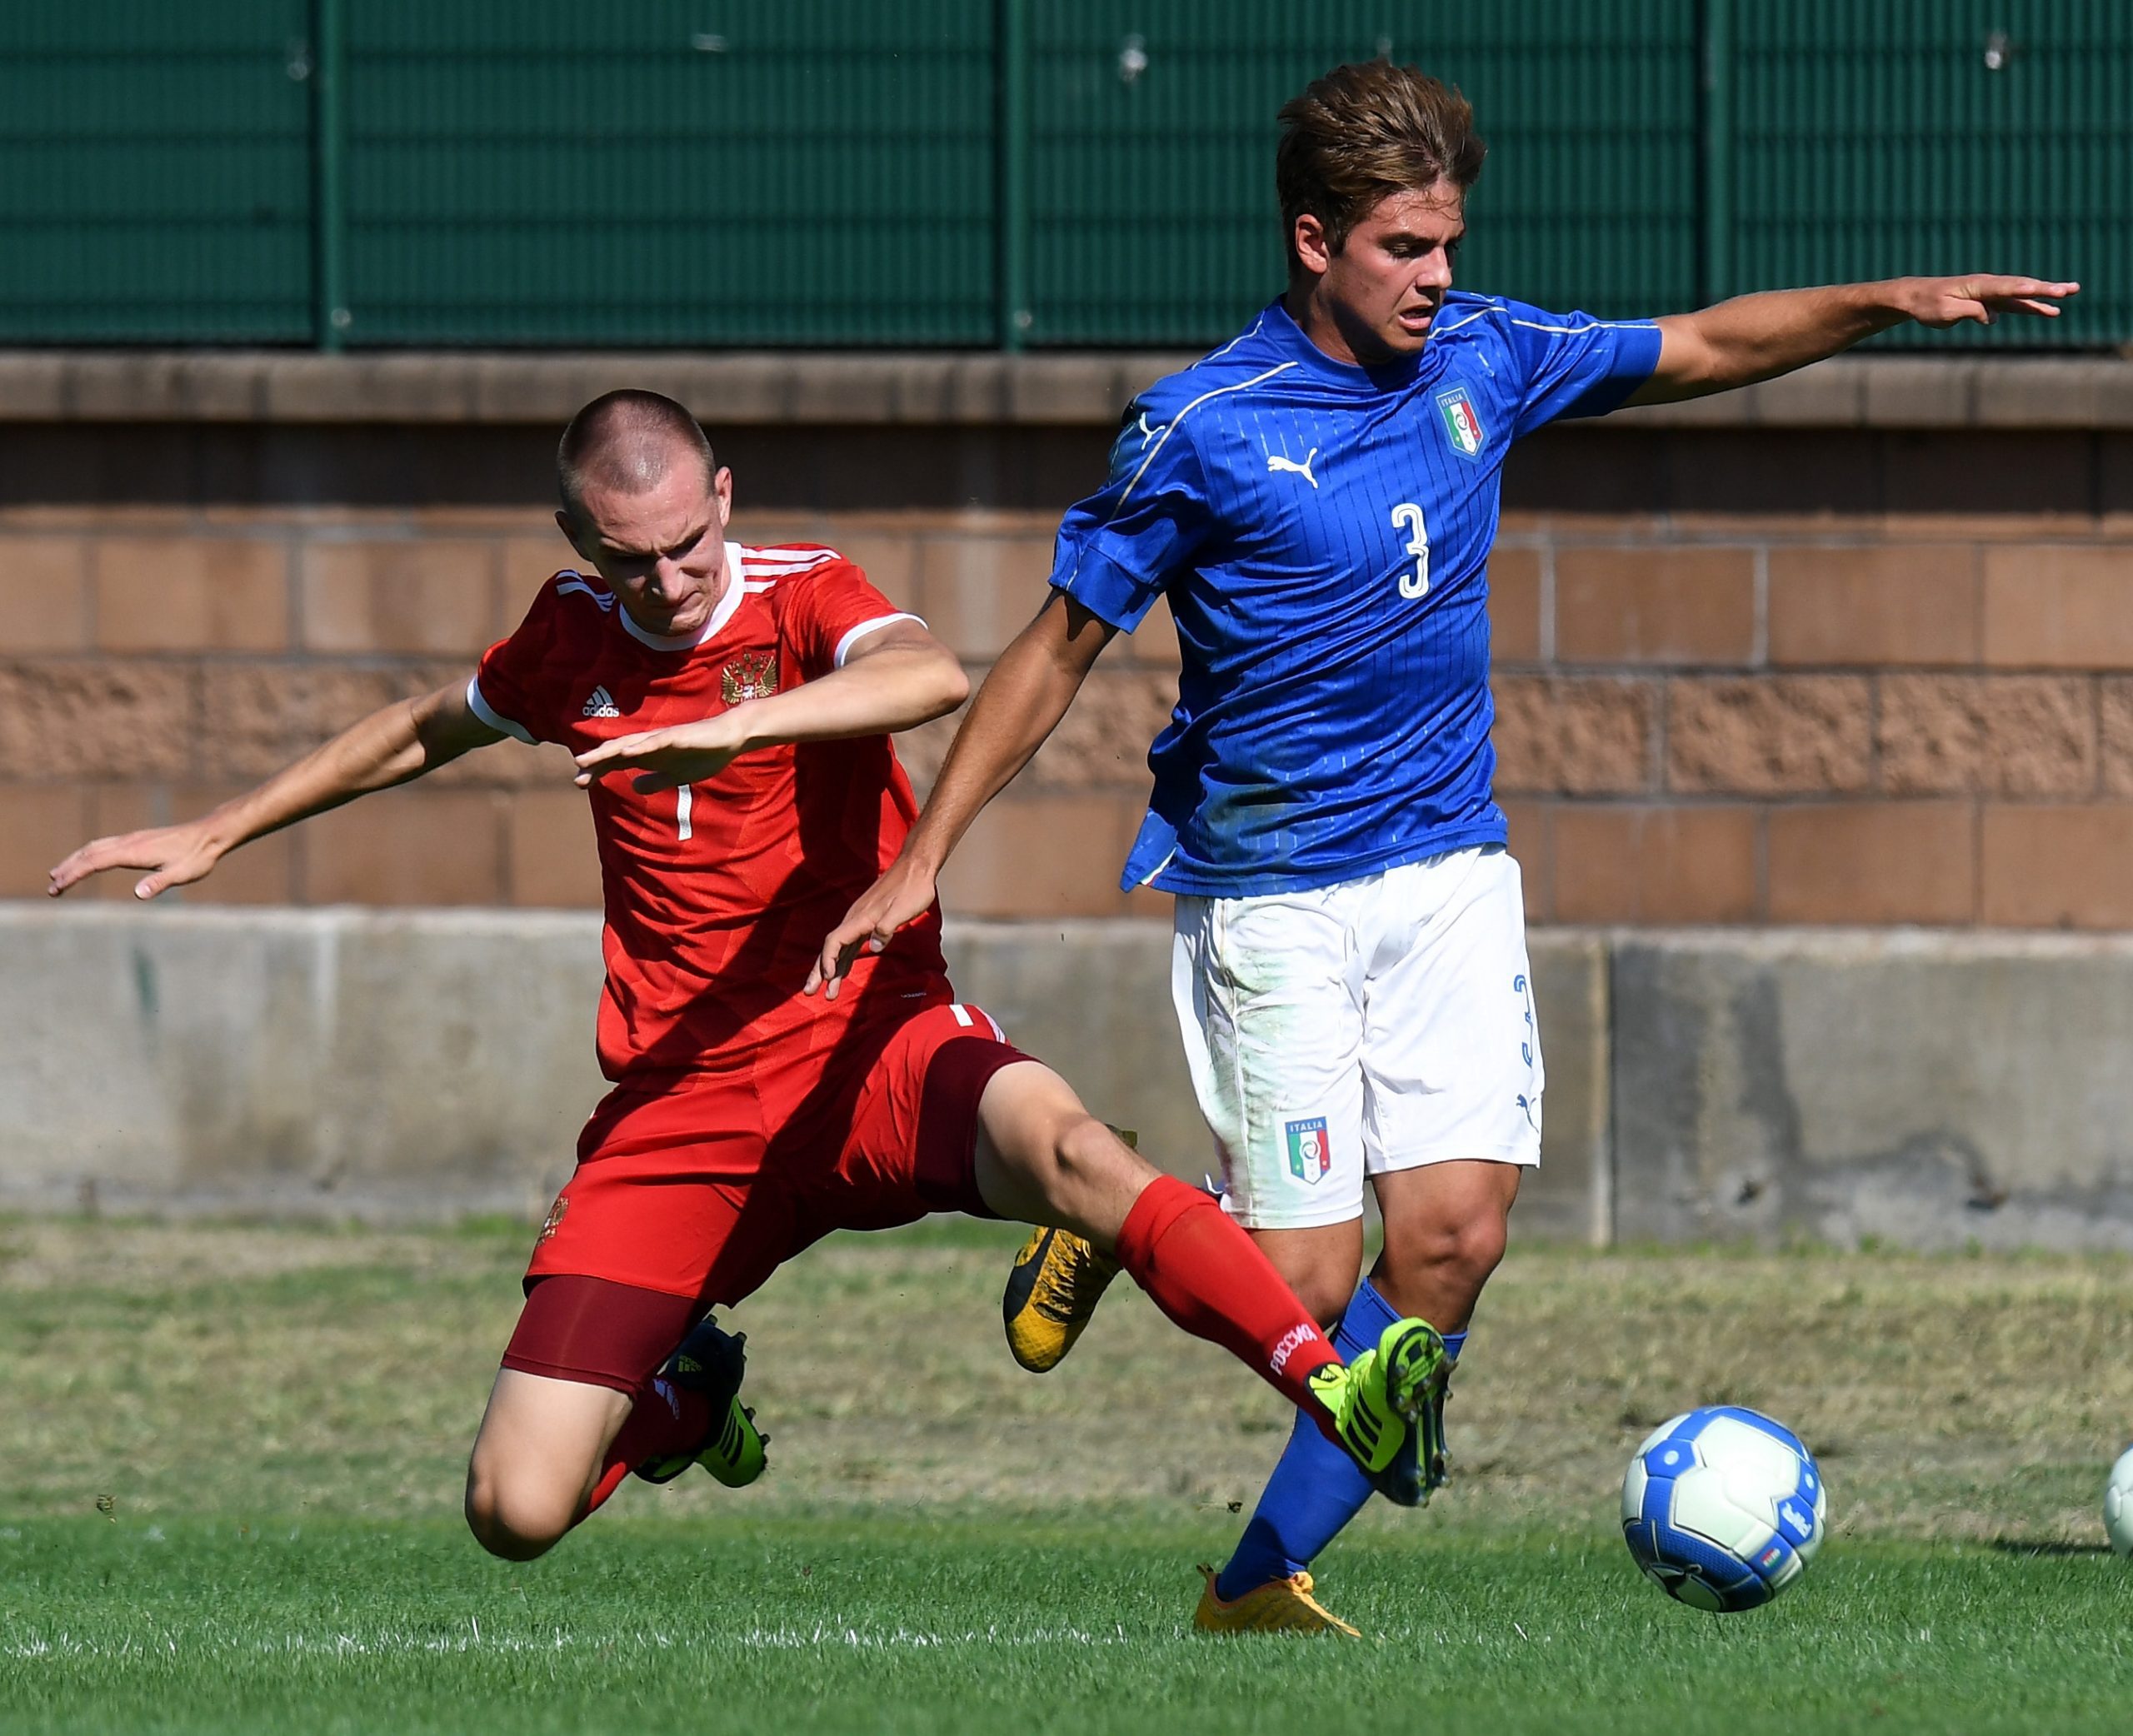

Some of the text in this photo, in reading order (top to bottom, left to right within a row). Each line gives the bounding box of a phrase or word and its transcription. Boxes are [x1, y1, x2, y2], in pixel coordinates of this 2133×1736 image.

[1441, 393, 1464, 407] ITALIA
[1391, 502, 1430, 599] 3
[582, 704, 620, 717] adidas
[1290, 1120, 1323, 1132] ITALIA
[1270, 1323, 1318, 1376] РОССИЯ
